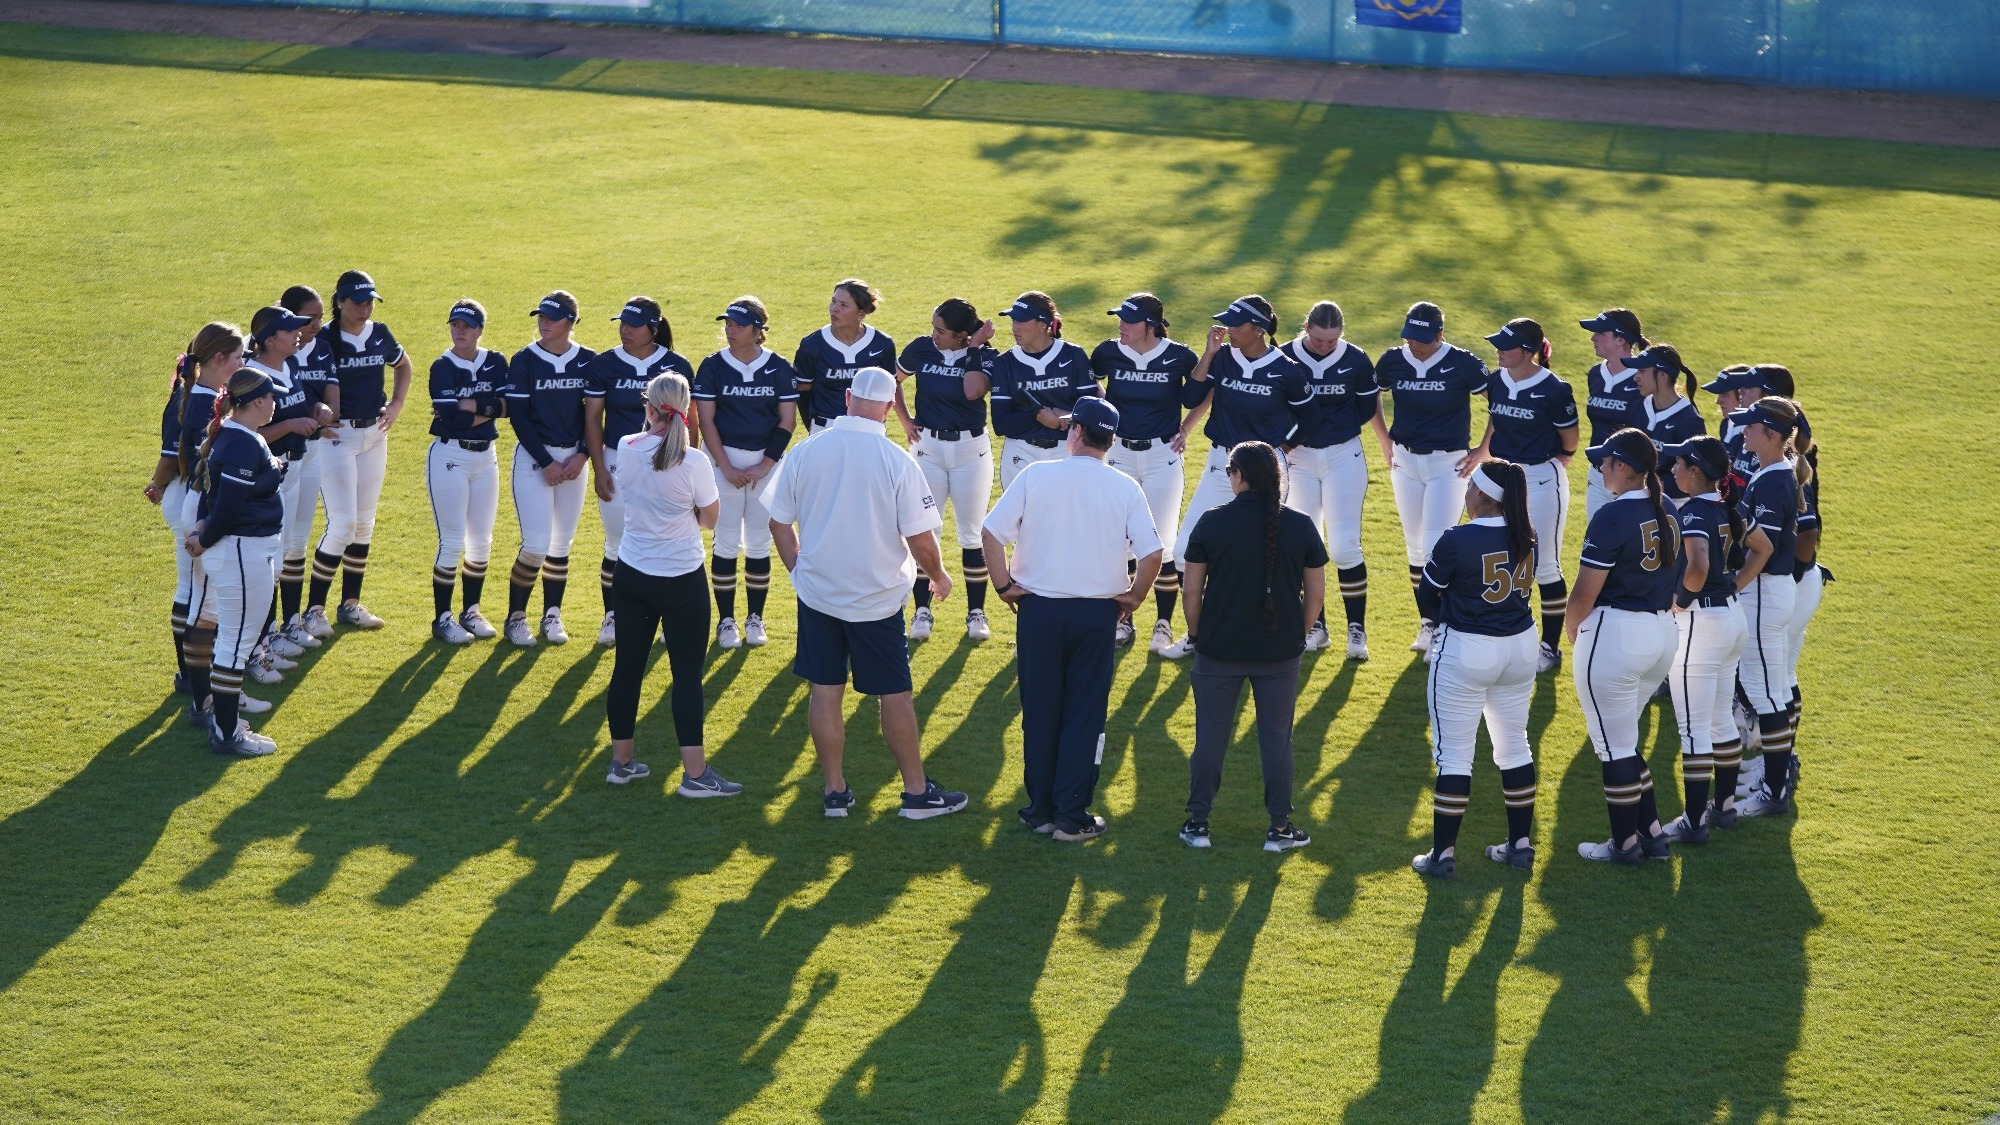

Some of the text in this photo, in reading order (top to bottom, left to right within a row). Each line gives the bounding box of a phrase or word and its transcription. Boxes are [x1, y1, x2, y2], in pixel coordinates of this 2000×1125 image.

[1408, 318, 1430, 328] LANCERS
[340, 355, 385, 368] LANCERS
[300, 370, 327, 381] NCERS
[826, 368, 858, 379] LANC
[922, 363, 966, 378] LANCER
[1114, 369, 1170, 383] LANCERS
[535, 378, 586, 390] LANCERS
[615, 378, 649, 389] LANC
[1221, 377, 1273, 396] LANCERS
[1312, 384, 1346, 395] NCERS
[1396, 380, 1446, 391] LANCERS
[722, 386, 775, 397] LANCERS
[1588, 396, 1628, 411] LANCERS
[1490, 402, 1535, 420] LANCERS
[1481, 547, 1535, 604] 54
